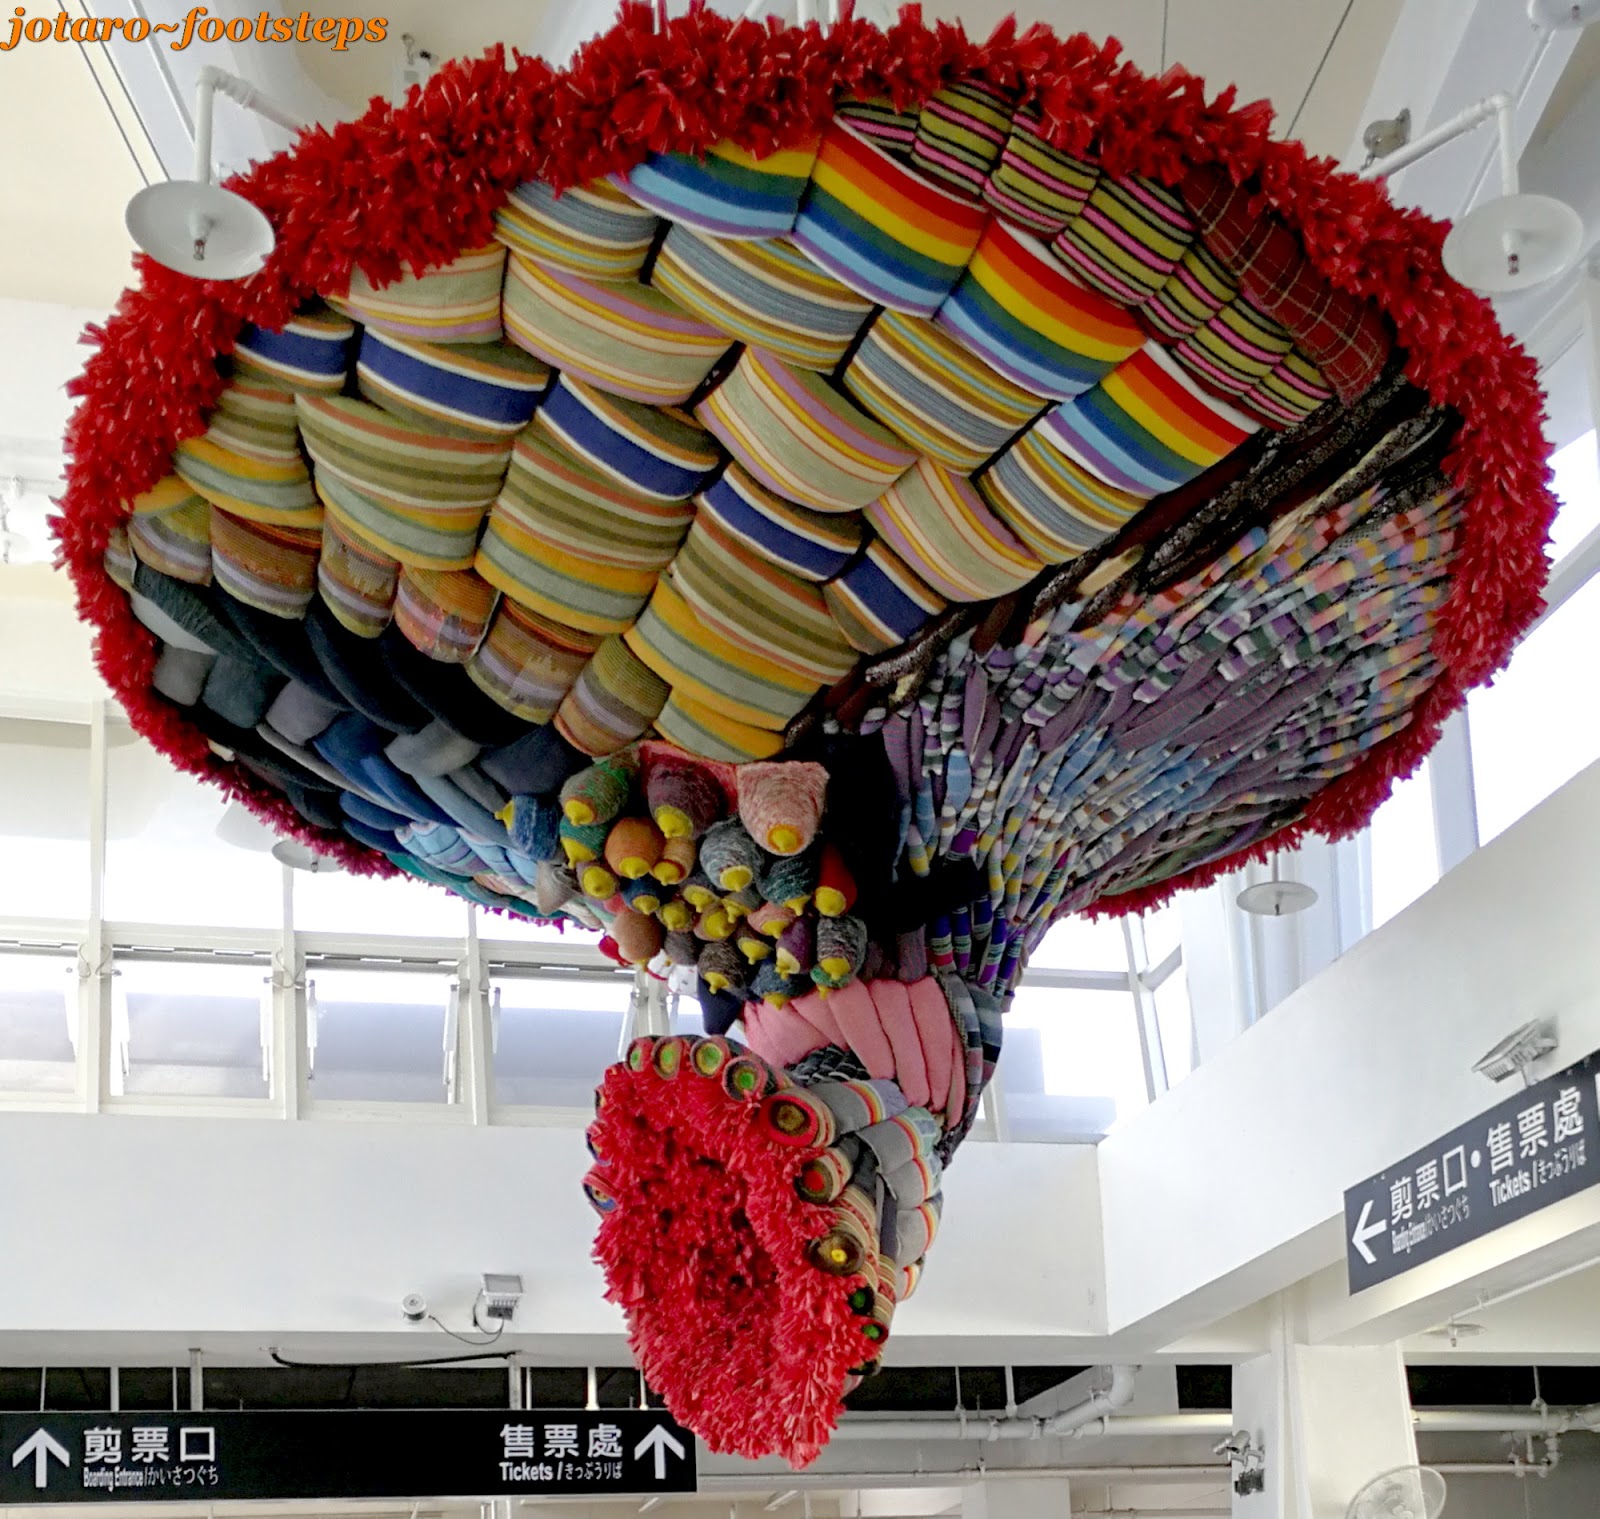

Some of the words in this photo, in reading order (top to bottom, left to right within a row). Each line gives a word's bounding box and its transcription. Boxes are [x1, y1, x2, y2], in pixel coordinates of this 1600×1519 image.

[1489, 1169, 1532, 1207] Tickets
[83, 1426, 216, 1464] 剪票口
[499, 1423, 624, 1459] 售票處
[498, 1461, 554, 1481] Tickets
